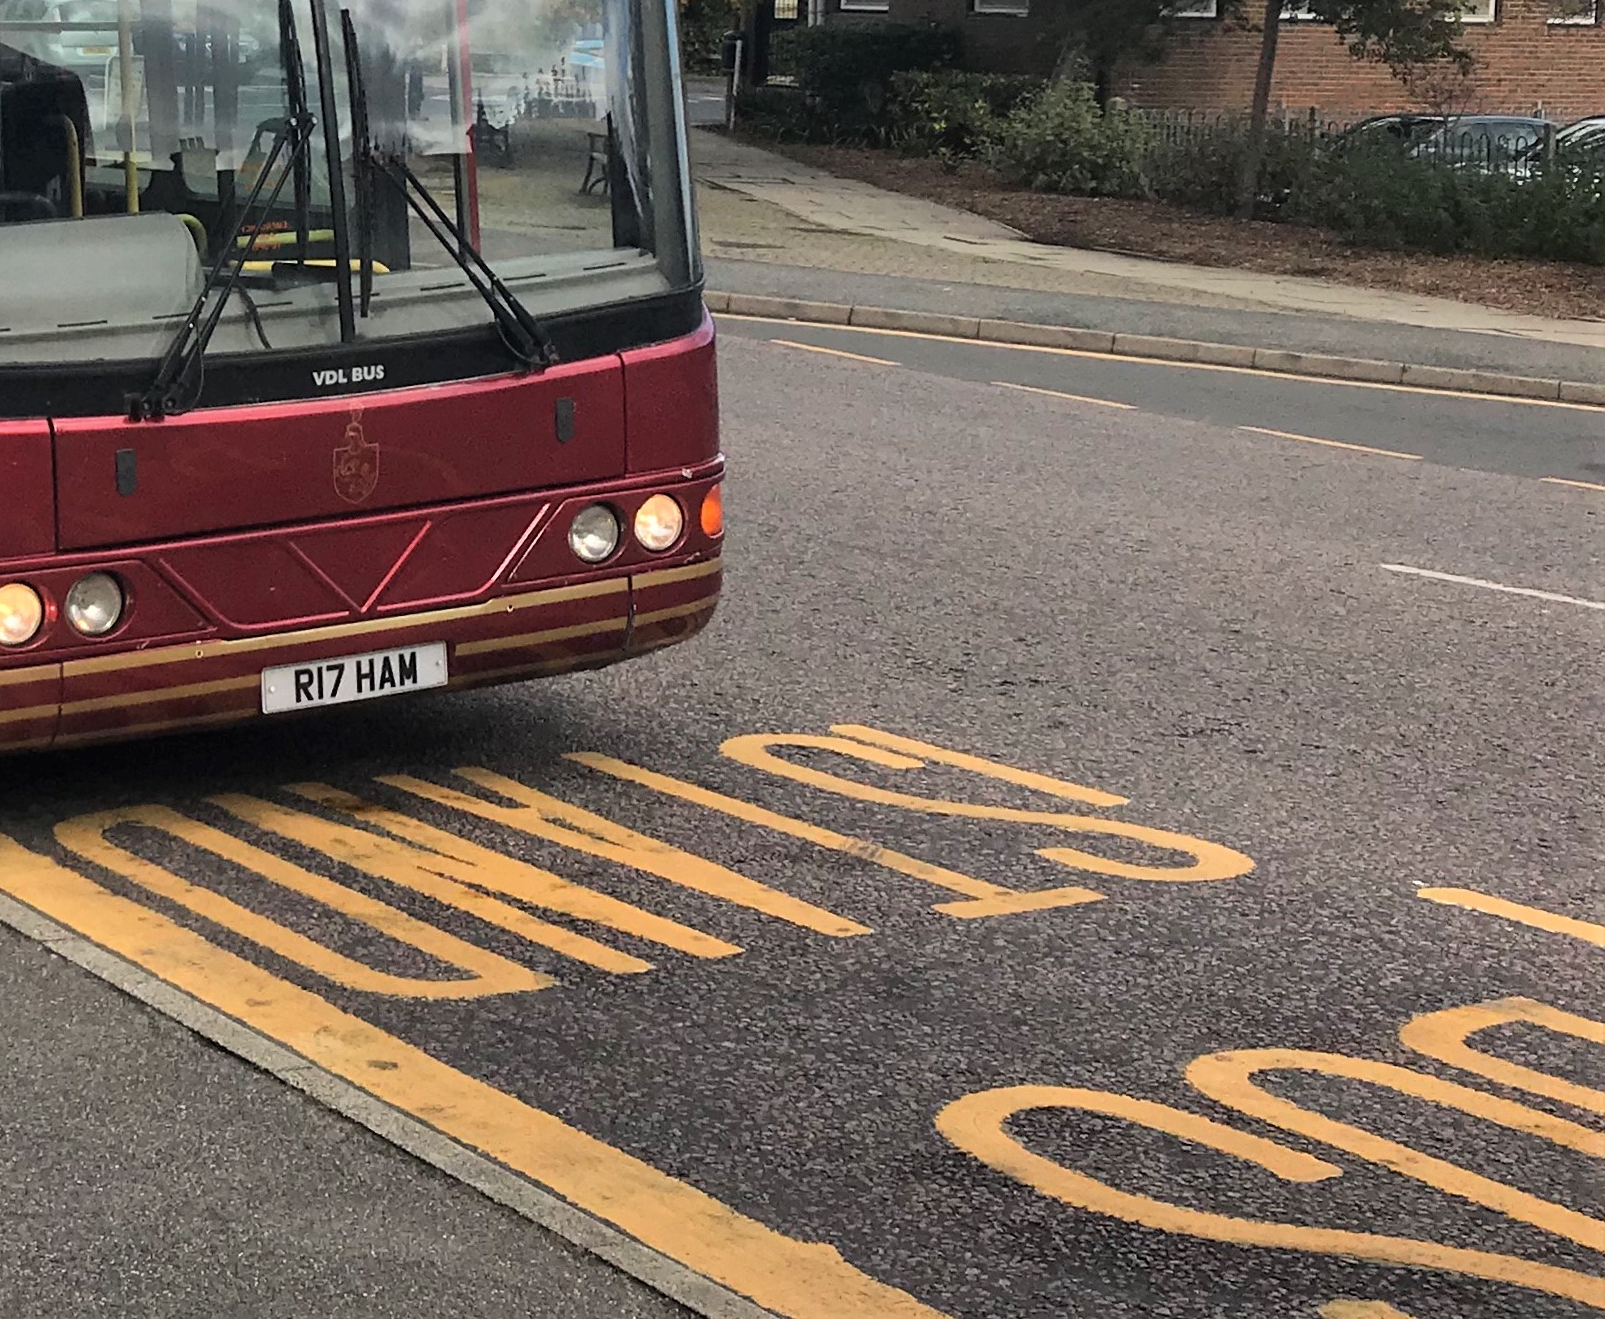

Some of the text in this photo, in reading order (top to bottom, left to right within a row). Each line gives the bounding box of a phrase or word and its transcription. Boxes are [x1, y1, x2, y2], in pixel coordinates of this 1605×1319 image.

[312, 364, 385, 386] VDL BUS
[294, 651, 419, 703] R17 HAM
[53, 723, 1257, 1001] STAND
